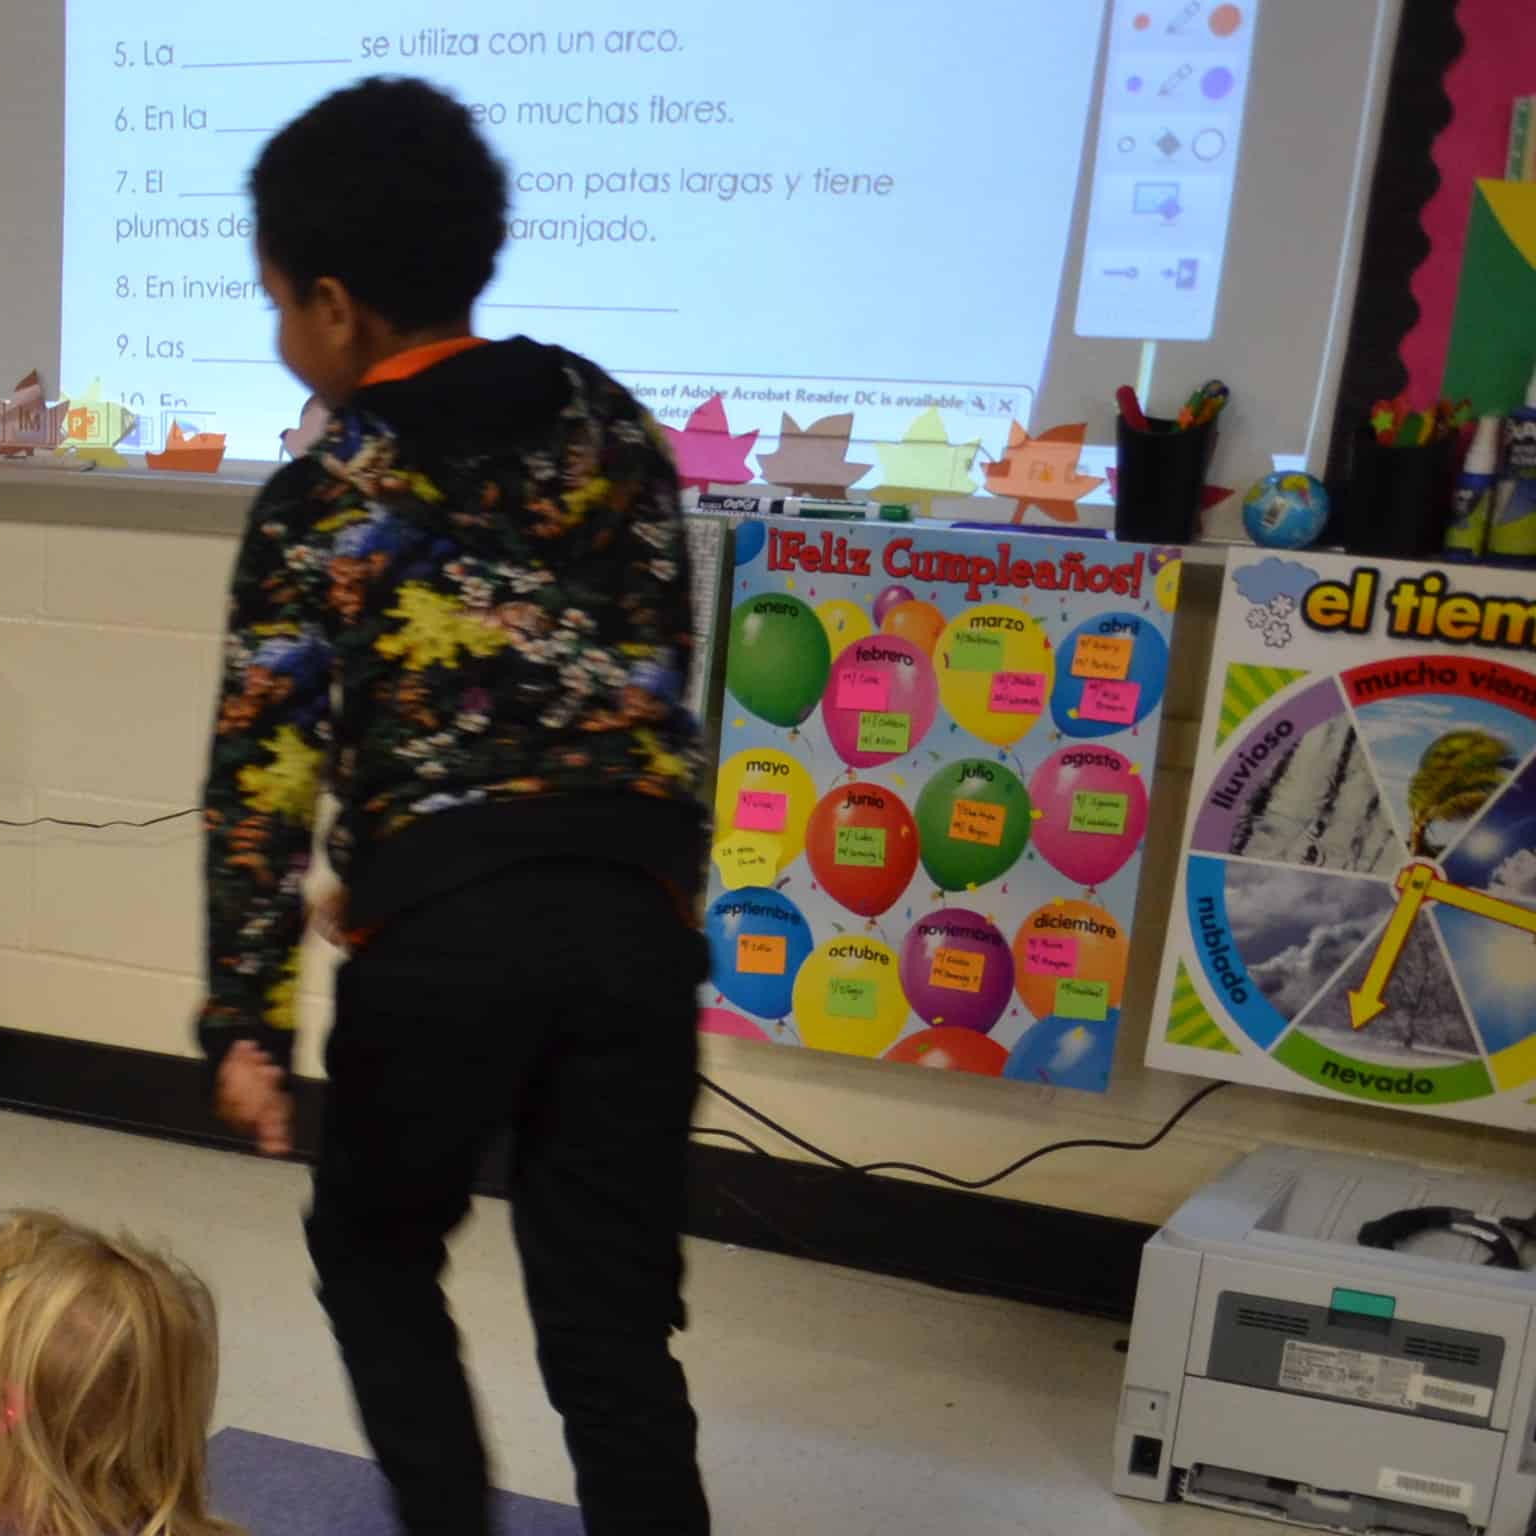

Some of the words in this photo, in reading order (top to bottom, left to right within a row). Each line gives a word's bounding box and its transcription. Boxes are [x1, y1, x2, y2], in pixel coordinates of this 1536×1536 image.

[114, 40, 134, 67] 5.
[143, 40, 174, 65] La
[360, 32, 390, 58] se
[399, 27, 479, 57] utiliza
[489, 30, 546, 56] con
[558, 28, 593, 54] un
[604, 26, 684, 54] arco.
[114, 106, 134, 132] 6.
[145, 105, 174, 130] En
[183, 104, 207, 130] la
[470, 103, 506, 124] eo
[517, 95, 638, 125] muchas
[649, 96, 734, 126] flores.
[115, 170, 135, 193] 7.
[146, 170, 163, 193] El
[516, 172, 574, 192] con
[584, 168, 670, 199] patas
[679, 167, 774, 201] largas
[785, 172, 801, 200] y
[812, 168, 894, 196] tiene
[116, 213, 209, 243] plumas
[217, 213, 251, 239] de
[509, 212, 656, 246] aranjado.
[116, 276, 136, 299] 8.
[146, 276, 174, 297] En
[116, 334, 136, 359] 9.
[146, 335, 184, 358] Las
[661, 383, 677, 398] of
[732, 385, 794, 403] Acrobat
[797, 388, 851, 406] Reader
[854, 391, 876, 407] DC
[881, 392, 892, 407] is
[895, 393, 964, 410] available
[768, 527, 871, 577] ¡Feliz
[883, 537, 1145, 602] Cumpleaños!
[753, 601, 799, 619] enero
[1301, 565, 1378, 634] el
[970, 614, 1025, 633] marzo
[1099, 618, 1140, 636] abril
[856, 646, 914, 666] febrero
[1354, 660, 1458, 697] mucho
[746, 759, 790, 777] mayo
[956, 762, 995, 784] julio
[1061, 750, 1122, 772] agosto
[1209, 717, 1296, 812] lluvioso
[844, 790, 884, 809] junio
[714, 901, 801, 926] septiembre
[1033, 912, 1117, 940] diciembre
[918, 922, 1003, 947] noviembre
[828, 944, 889, 967] octubre
[1197, 894, 1250, 1007] nublado
[1319, 1058, 1435, 1097] nevado
